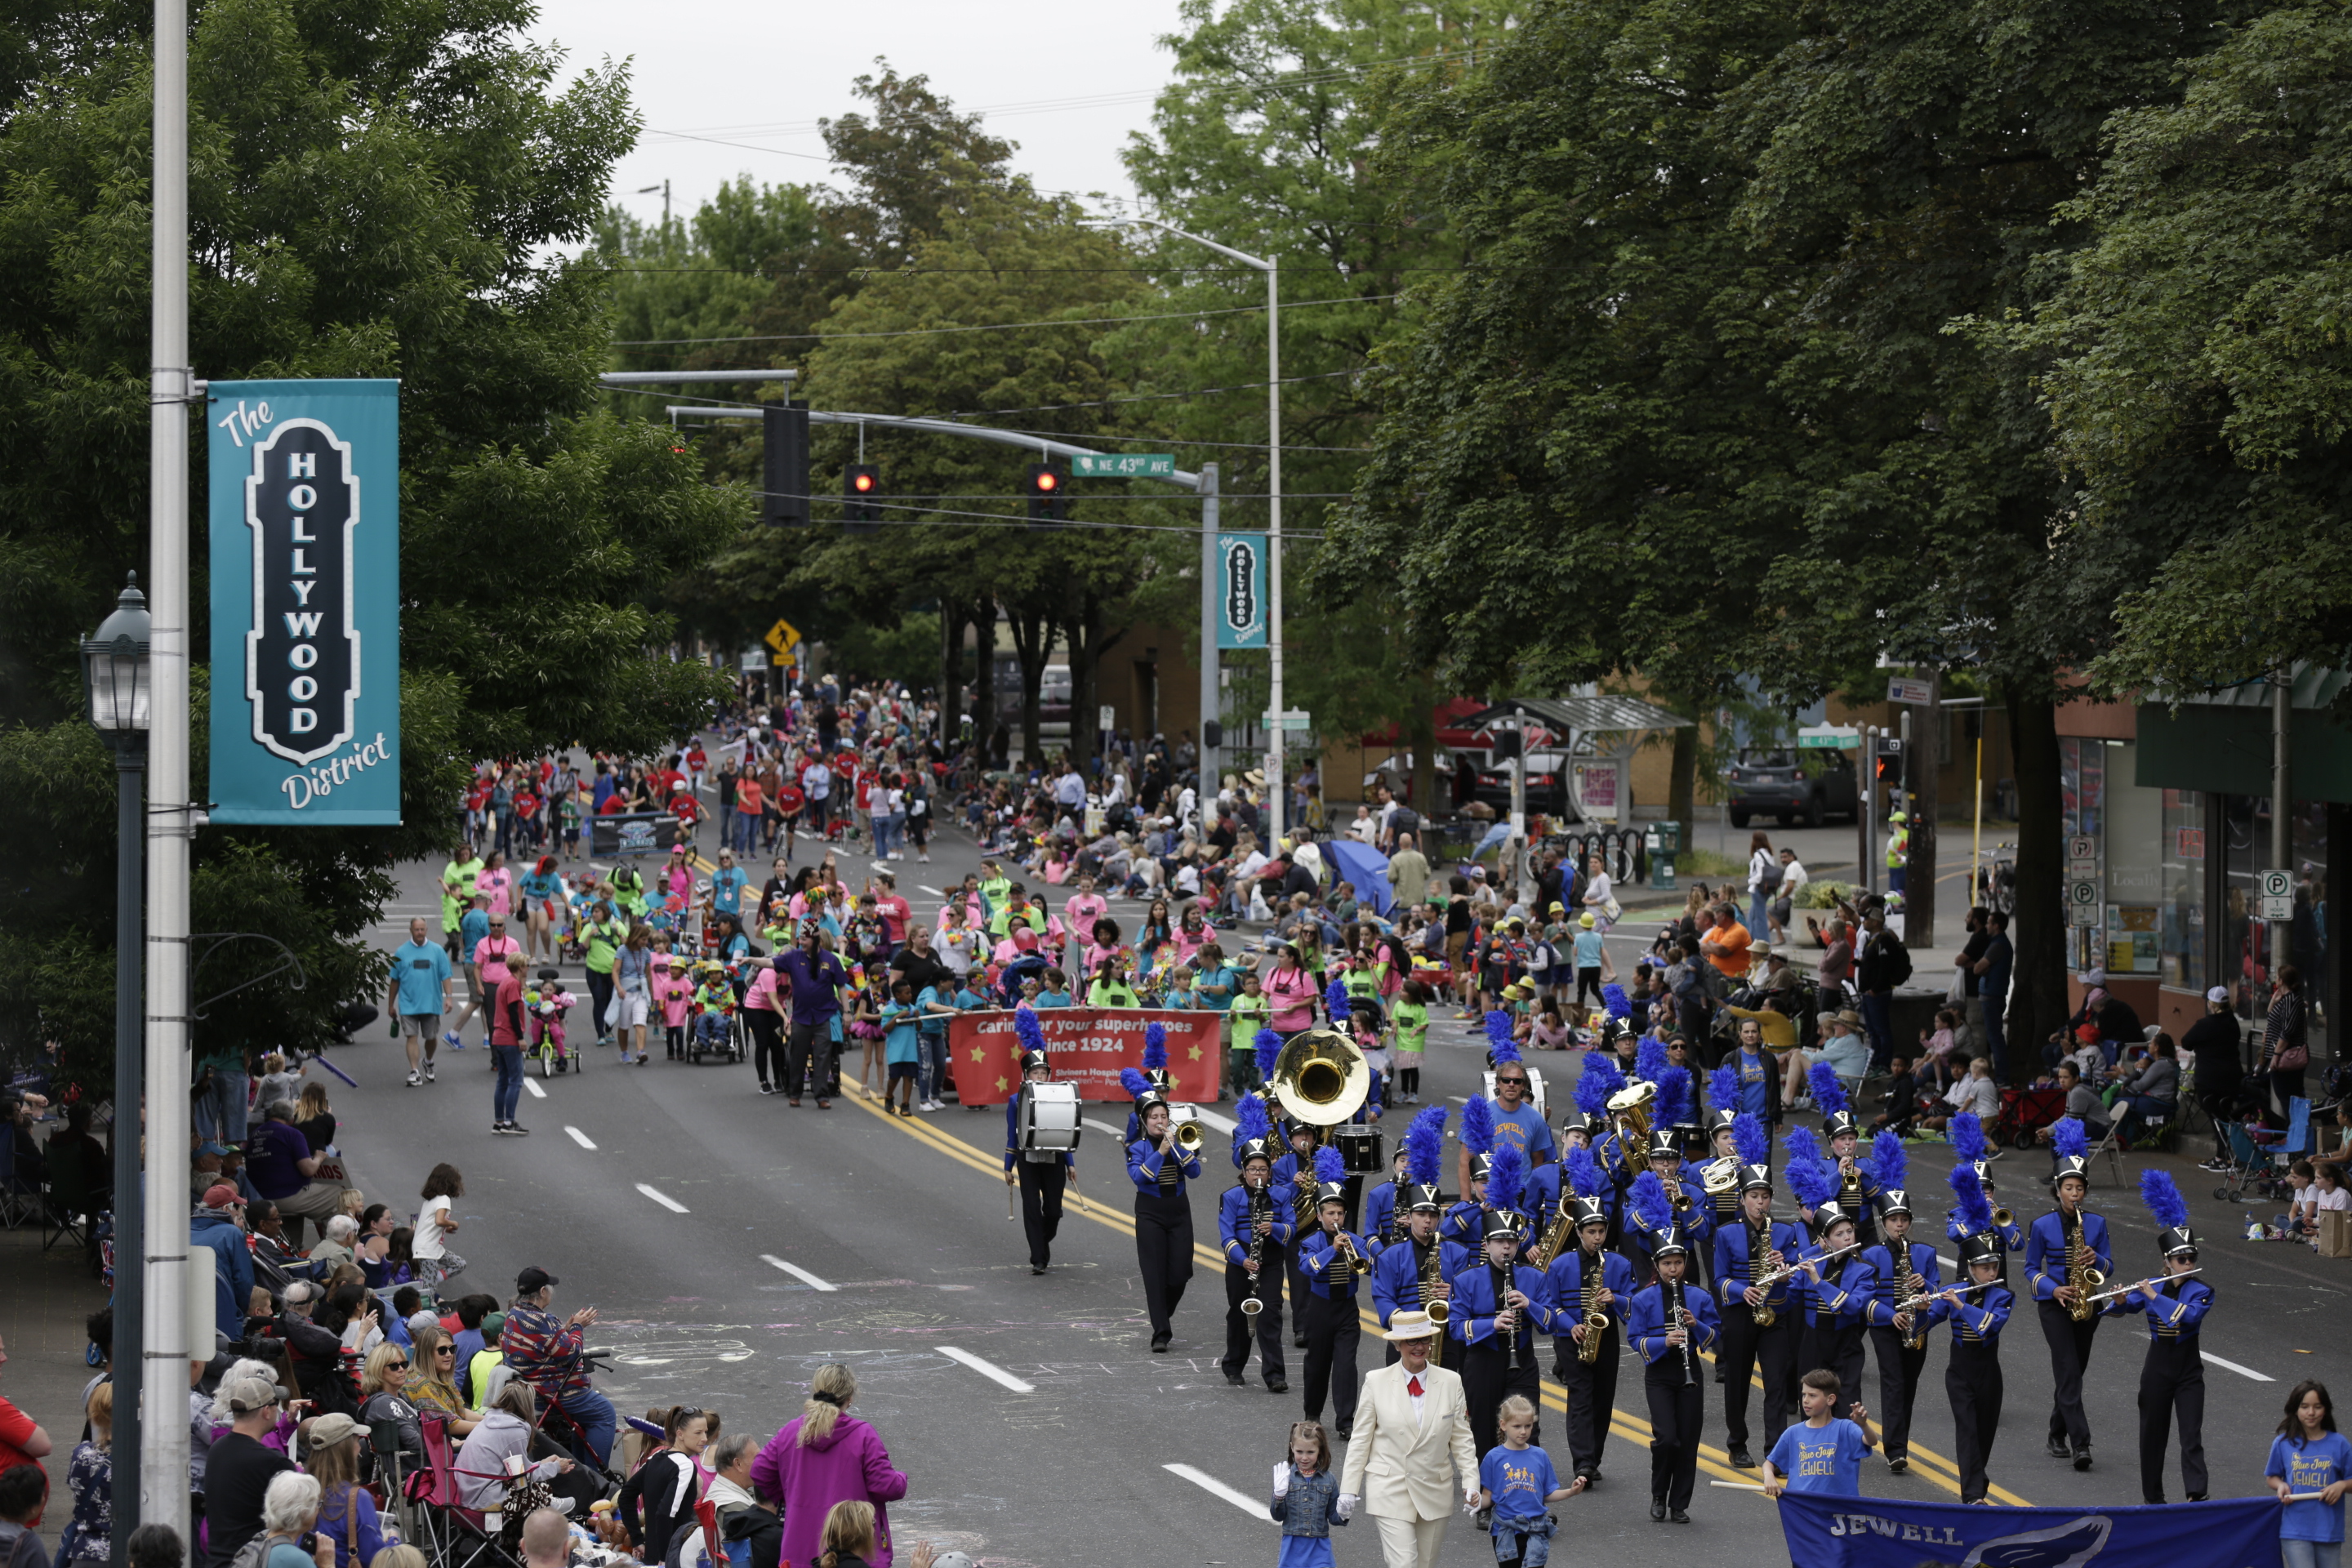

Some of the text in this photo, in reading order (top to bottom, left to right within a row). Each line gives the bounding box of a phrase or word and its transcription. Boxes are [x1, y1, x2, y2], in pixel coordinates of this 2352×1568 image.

[217, 399, 274, 448] The
[1098, 459, 1113, 471] NE
[1150, 461, 1170, 473] AVE
[1218, 536, 1234, 550] The
[283, 452, 323, 735] HOLLYWOOD
[1235, 550, 1247, 624] HOLLYWOOD
[1234, 621, 1264, 644] District
[279, 730, 391, 809] District
[2112, 872, 2159, 891] Locally
[2272, 878, 2283, 891] P
[977, 1018, 1019, 1035] Carin
[1038, 1019, 1054, 1032] or
[1056, 1018, 1091, 1035] your
[1080, 1036, 1124, 1053] 1924
[1055, 1068, 1087, 1077] Shriners
[1744, 1072, 1766, 1083] JEWEL
[1494, 1122, 1526, 1138] JEWELL
[1799, 1446, 1835, 1462] Blue Jays
[1799, 1460, 1835, 1477] JEWELL
[2292, 1458, 2331, 1471] Blue Jays
[2292, 1471, 2328, 1487] JEWELL
[1830, 1513, 1963, 1546] JEWELL
